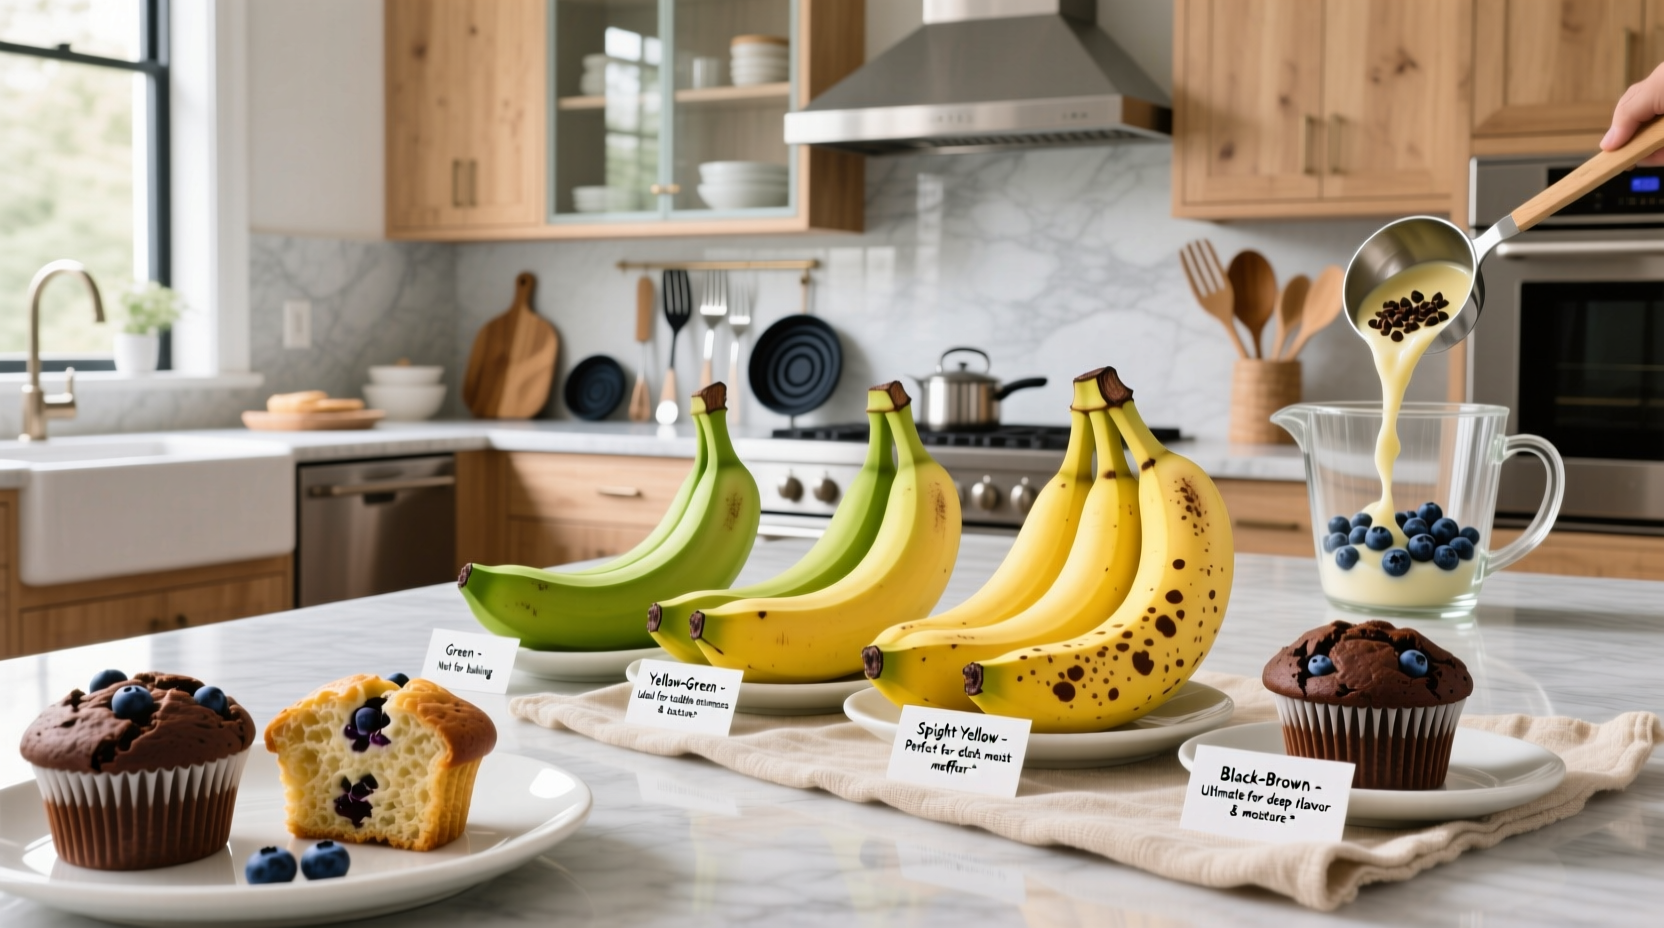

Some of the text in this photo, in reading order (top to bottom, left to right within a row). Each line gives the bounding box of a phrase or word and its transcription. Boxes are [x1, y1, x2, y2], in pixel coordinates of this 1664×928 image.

[446, 643, 474, 658] Green
[454, 662, 464, 672] for
[960, 725, 999, 744] Yellow
[1220, 765, 1311, 792] Black-Brown
[1247, 790, 1264, 803] for
[1266, 792, 1292, 812] deep
